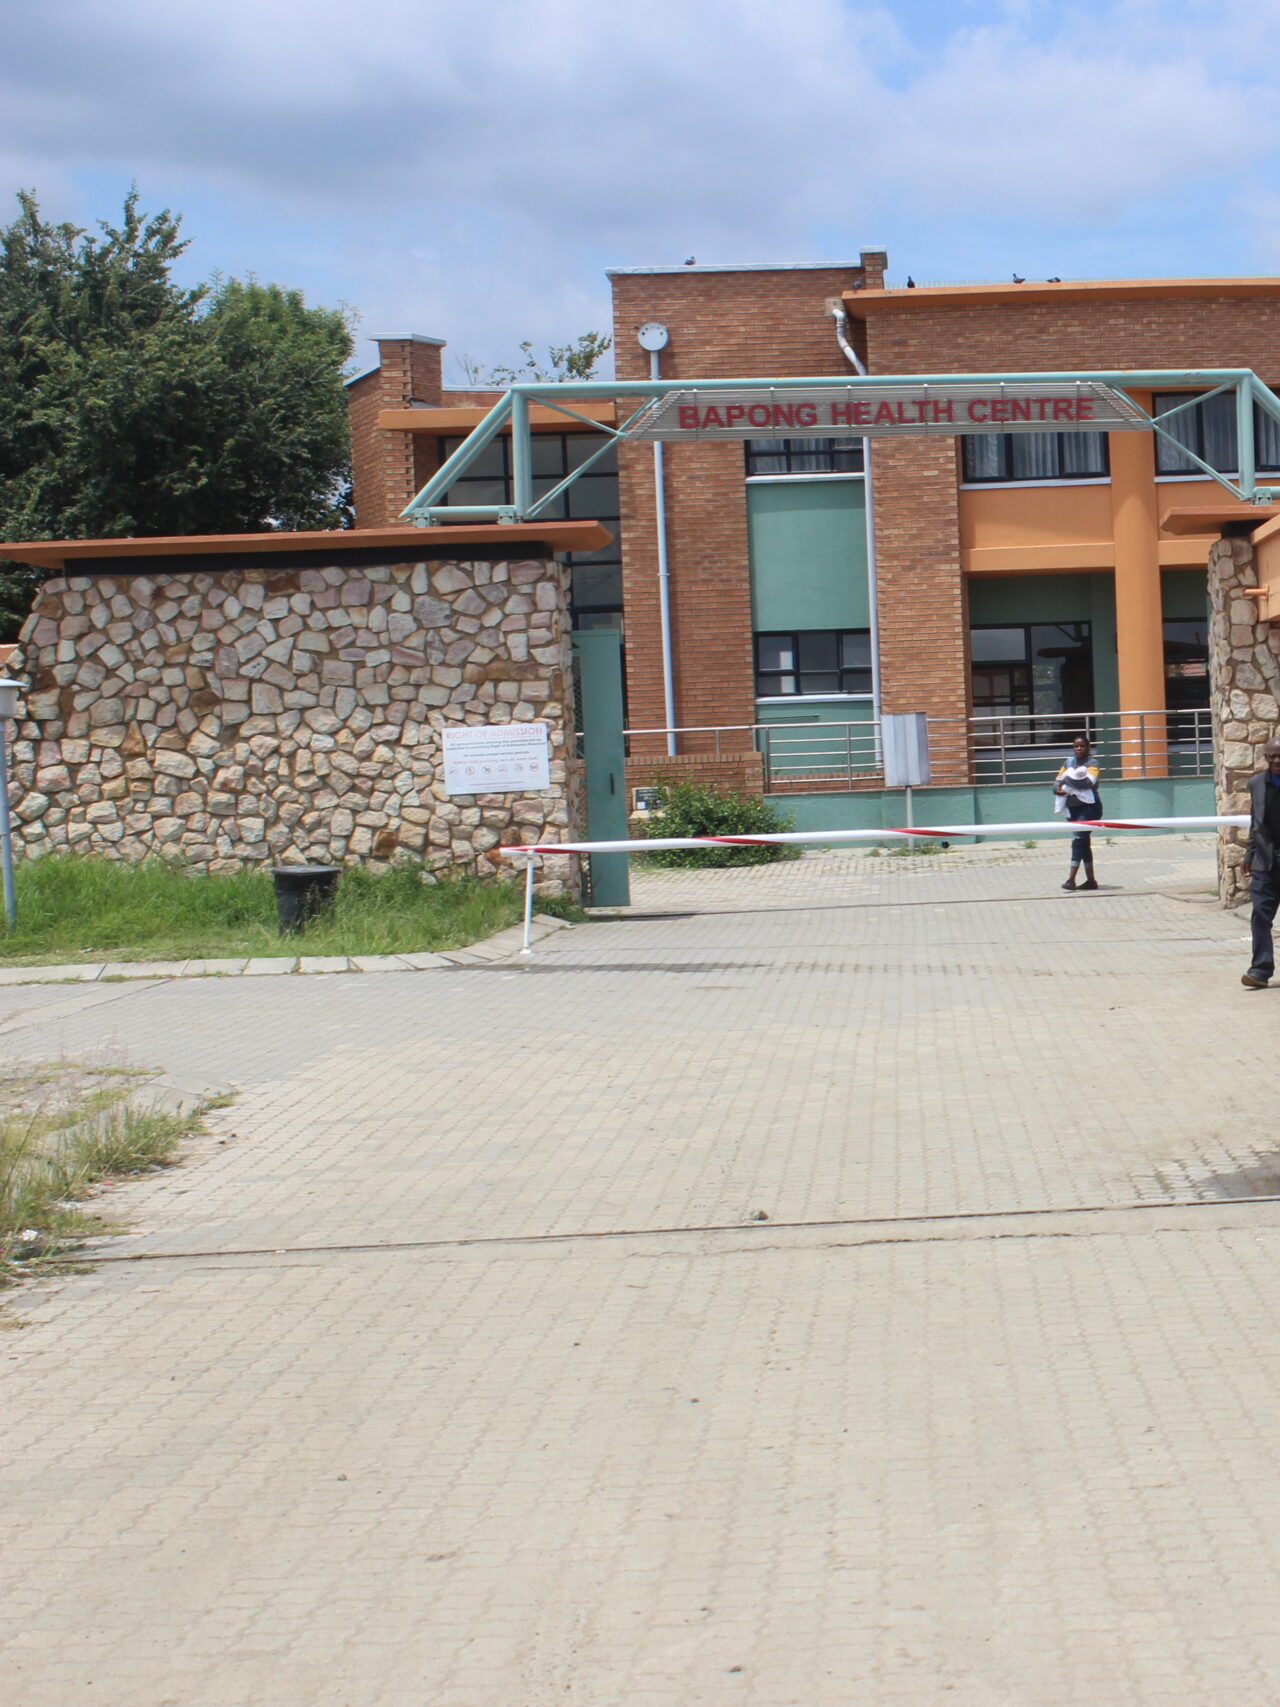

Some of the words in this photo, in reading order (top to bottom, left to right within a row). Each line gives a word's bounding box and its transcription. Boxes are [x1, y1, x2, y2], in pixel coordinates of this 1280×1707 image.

[678, 403, 818, 429] BAPONG
[831, 400, 954, 426] HEALTH
[967, 398, 1095, 423] CENTRE
[447, 730, 473, 740] RIGHT
[475, 730, 487, 738] OF
[491, 727, 543, 737] ADMISSION
